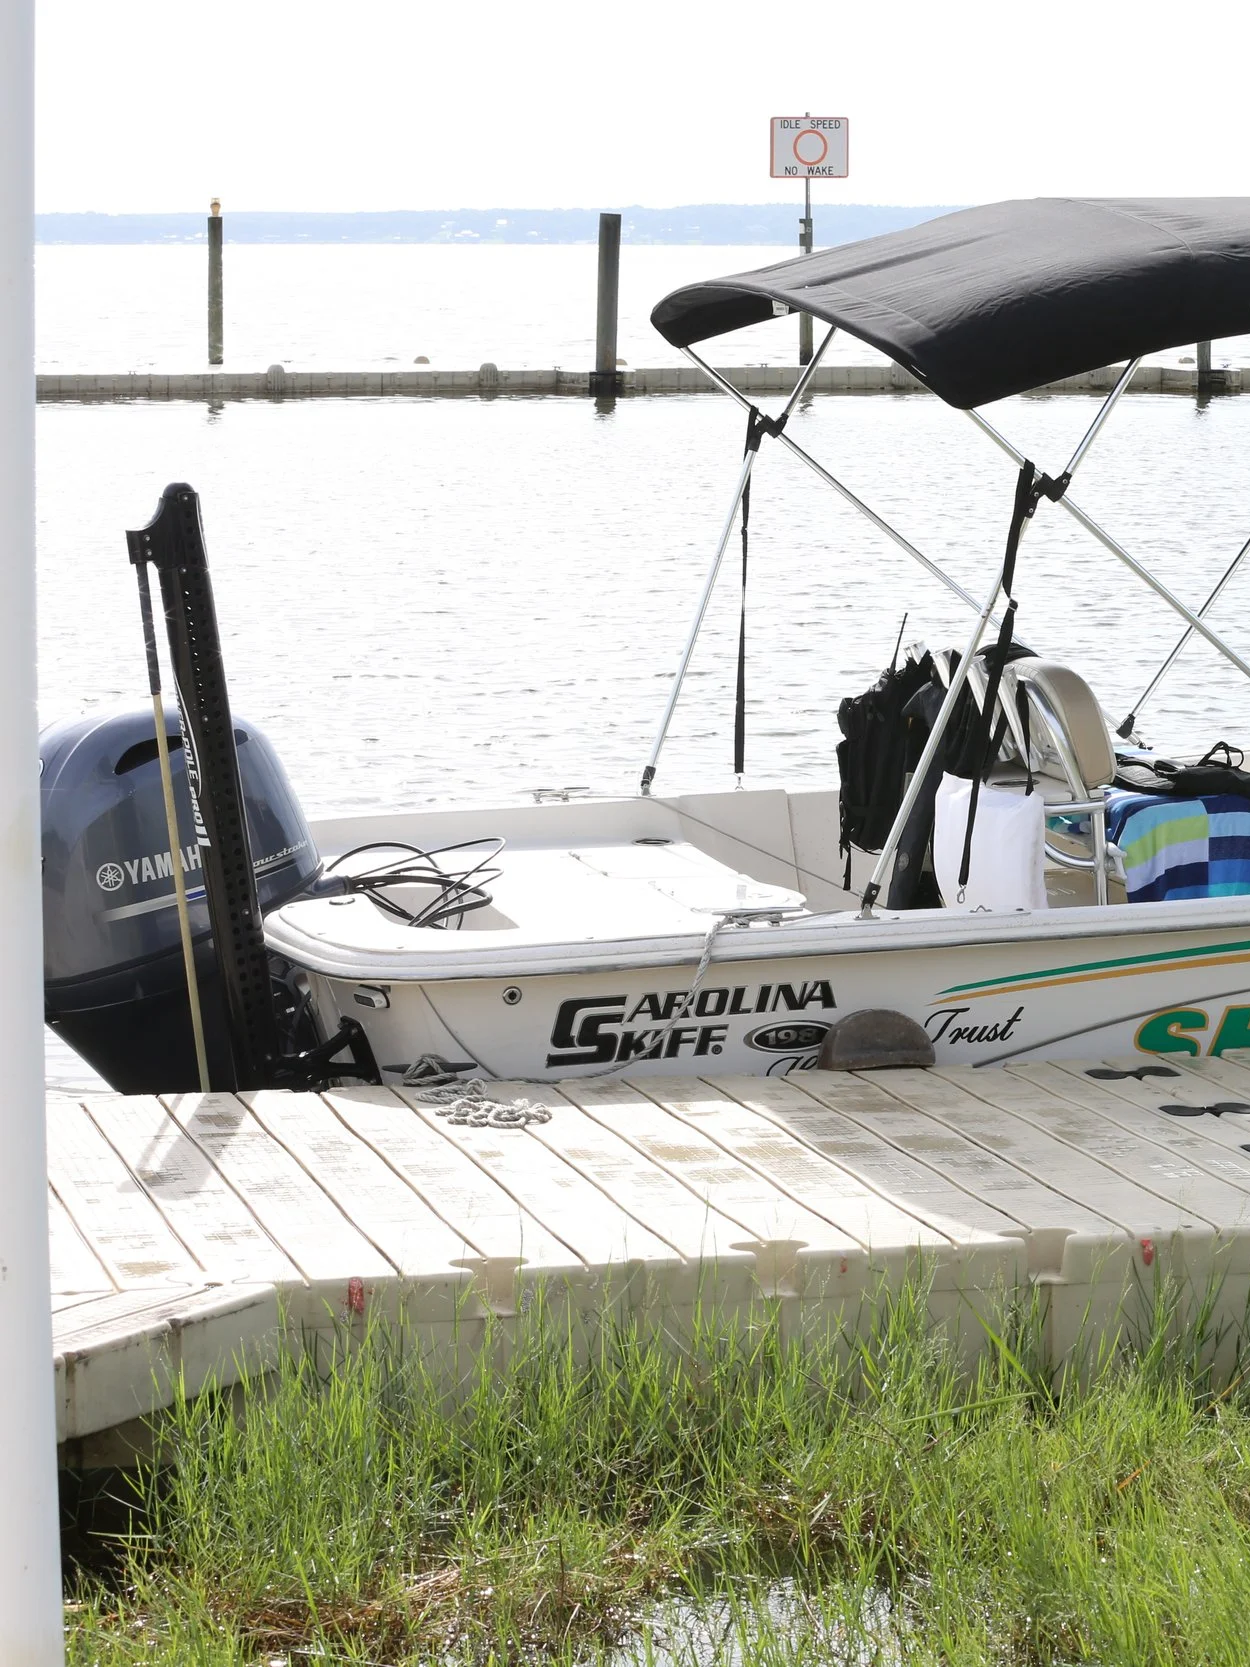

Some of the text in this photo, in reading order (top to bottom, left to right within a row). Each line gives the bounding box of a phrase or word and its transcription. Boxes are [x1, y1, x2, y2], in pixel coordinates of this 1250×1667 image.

[780, 119, 841, 129] IDLE SPEED
[784, 166, 834, 175] NO WAKE
[124, 844, 202, 884] YAMAH
[549, 980, 838, 1049] CAROLINA
[924, 1006, 1025, 1045] Trust
